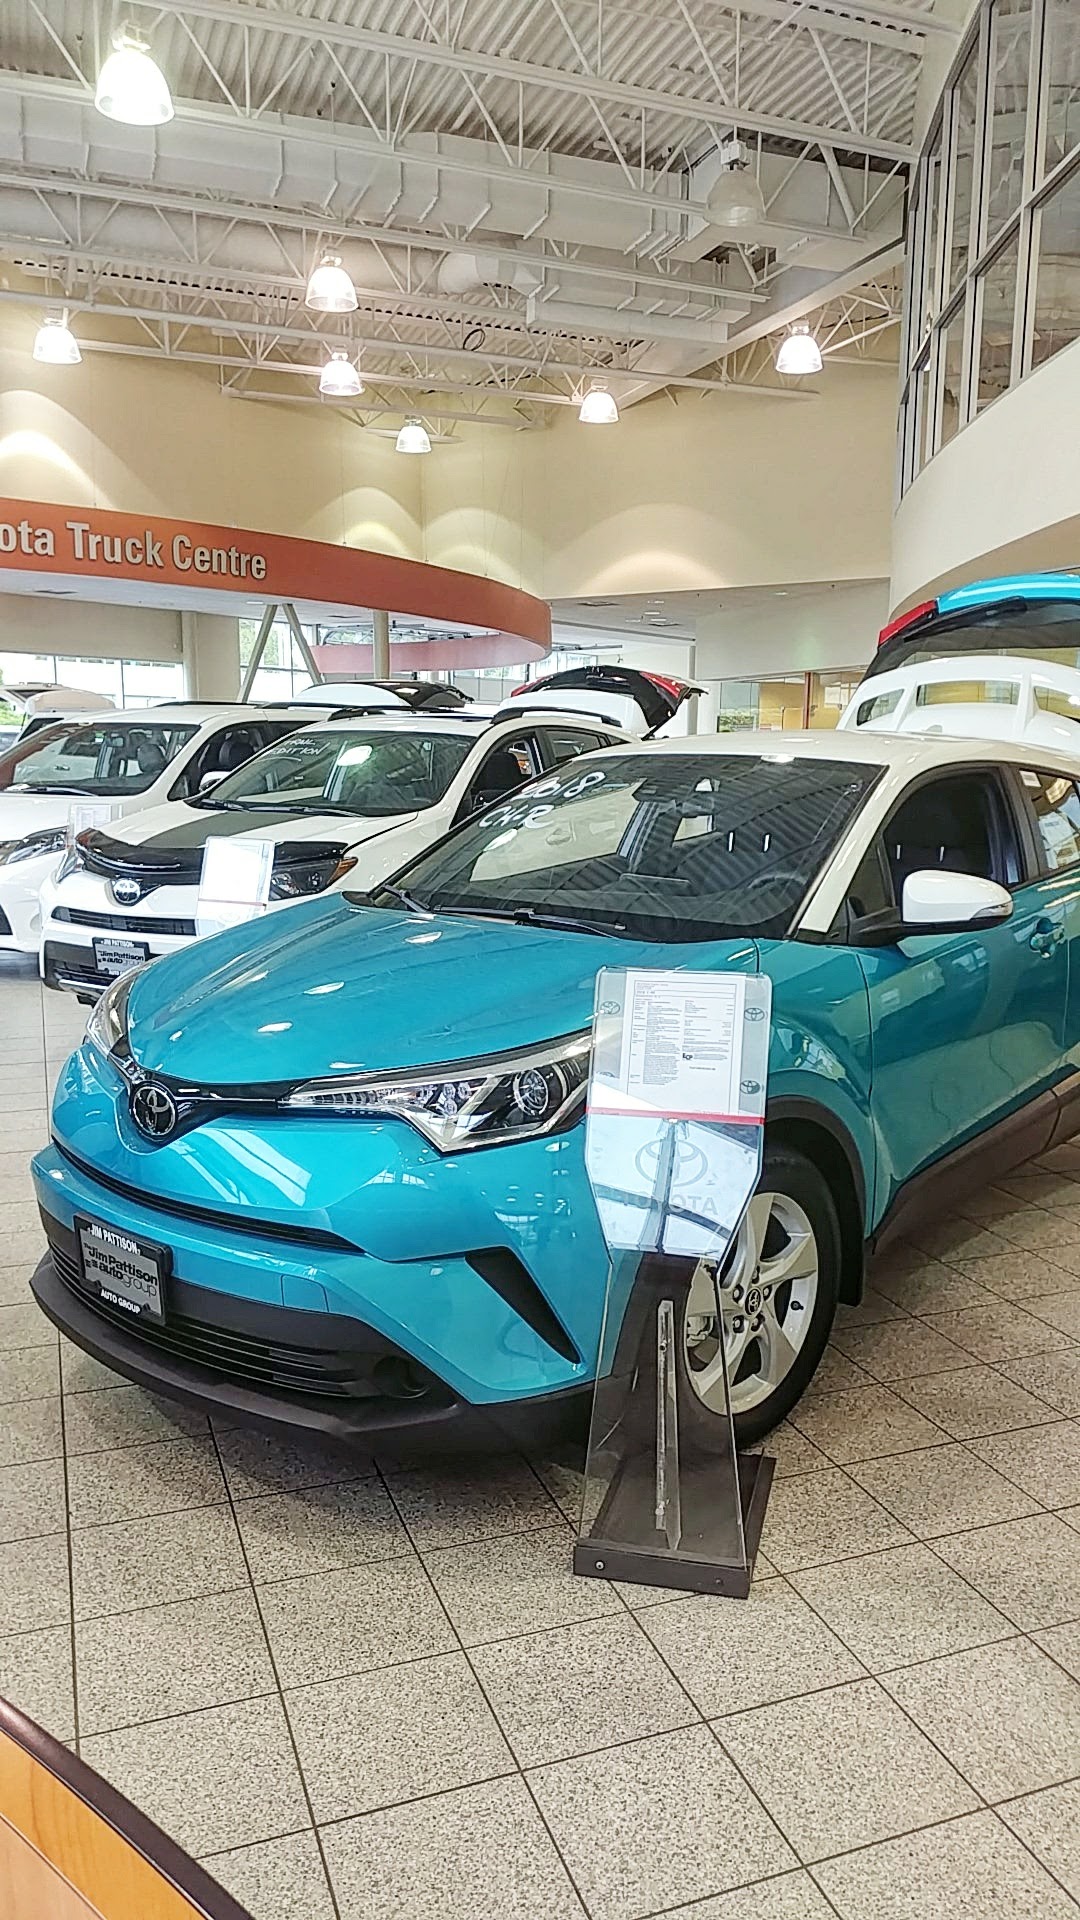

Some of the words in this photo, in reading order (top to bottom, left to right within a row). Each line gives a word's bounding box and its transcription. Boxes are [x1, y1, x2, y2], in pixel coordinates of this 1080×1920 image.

[0, 520, 55, 556] ota
[66, 521, 164, 567] Truck
[172, 535, 267, 580] Centre
[478, 804, 555, 829] CH-R
[91, 1223, 102, 1241] JIM
[103, 1228, 138, 1255] PATTISON
[101, 1288, 118, 1304] AUTO
[118, 1297, 141, 1314] GROUP
